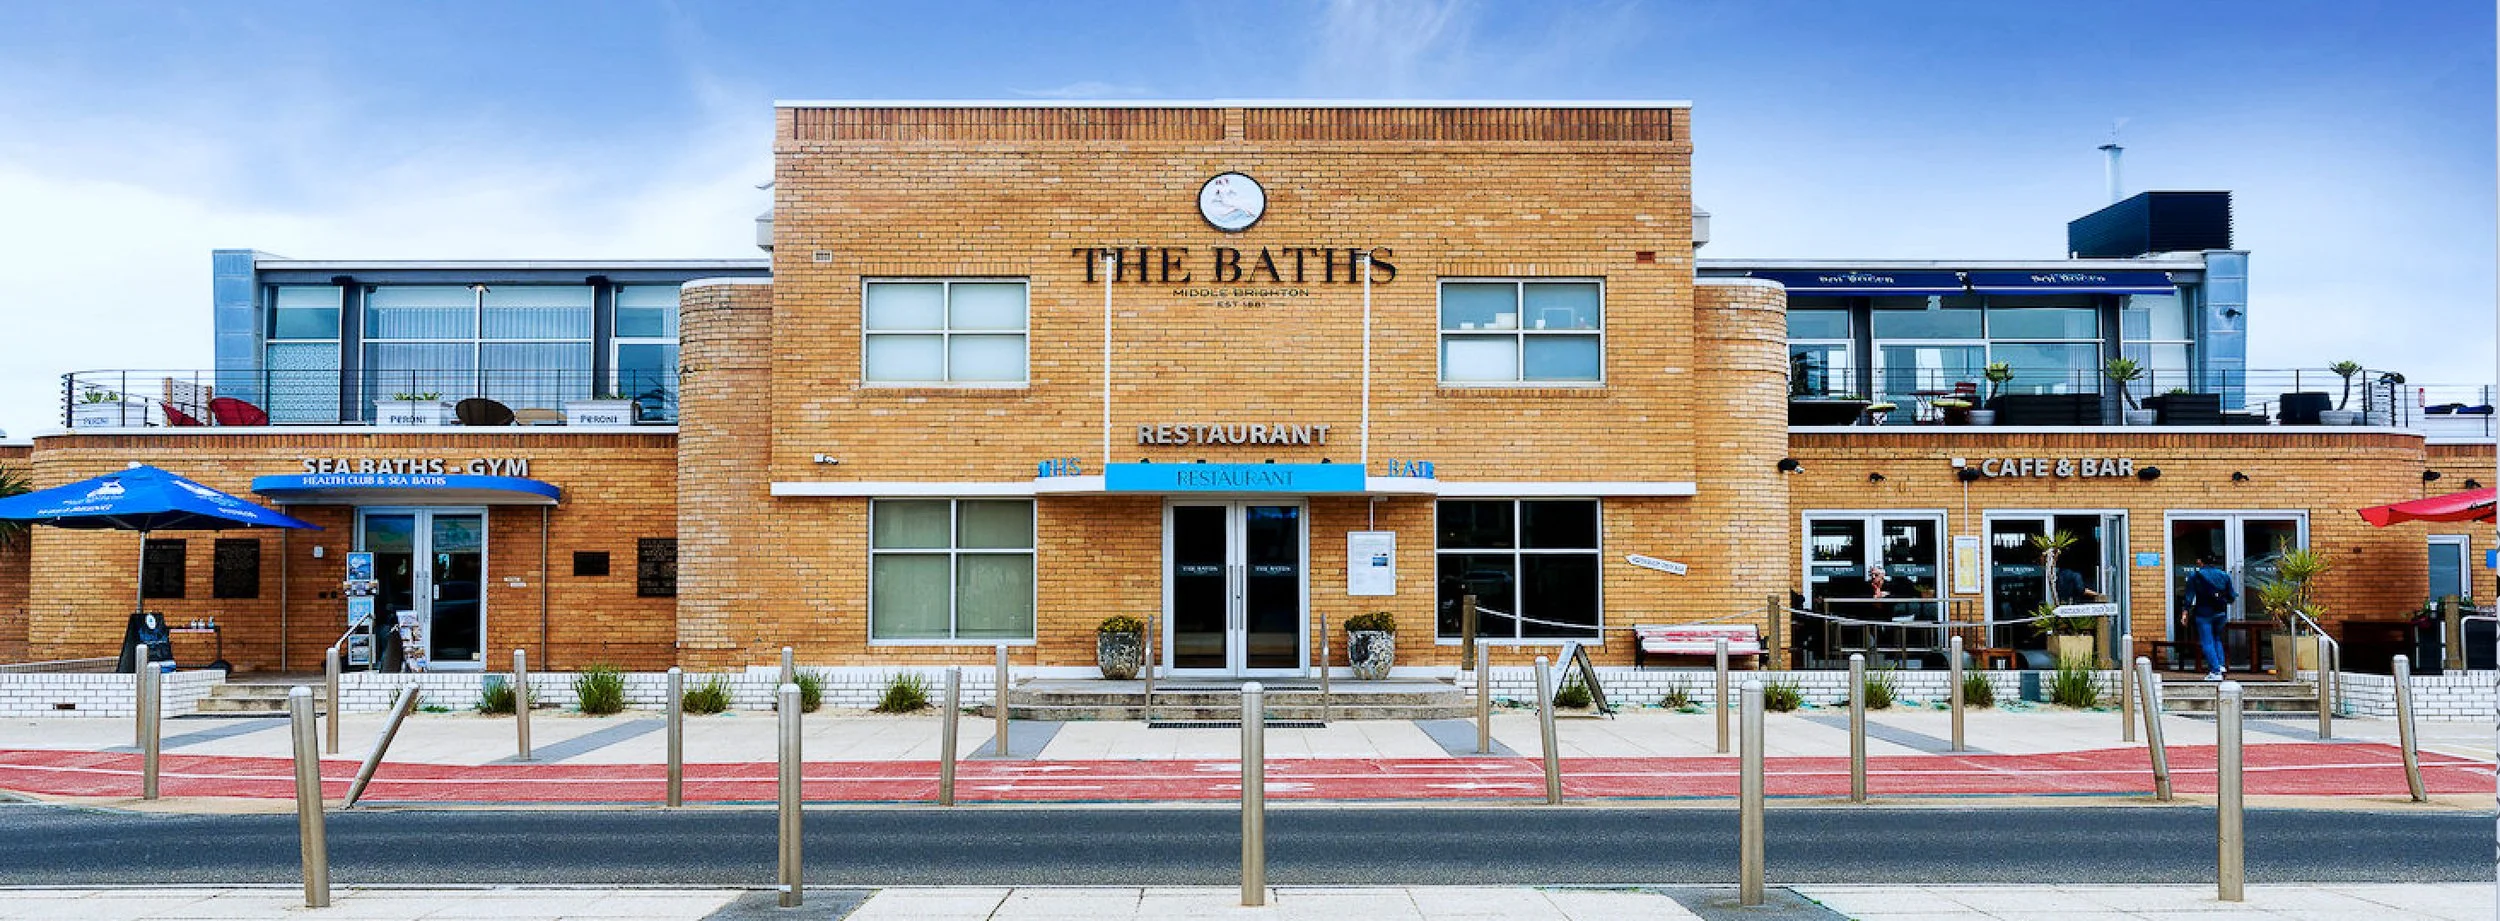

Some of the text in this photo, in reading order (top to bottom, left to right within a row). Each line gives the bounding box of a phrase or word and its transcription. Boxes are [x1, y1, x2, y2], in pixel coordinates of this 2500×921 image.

[1072, 246, 1397, 284] THE BATHS
[1172, 288, 1309, 297] MIDDLE BRIGHTON
[1137, 423, 1332, 445] RESTAURANT
[302, 458, 351, 474] SEA
[359, 458, 444, 474] BATHS
[467, 458, 530, 477] GYM
[1982, 458, 2134, 477] CAFE & BAR
[303, 476, 446, 485] HEALTH CLUB & SEA BATHS
[1176, 470, 1294, 486] RESTAURANT
